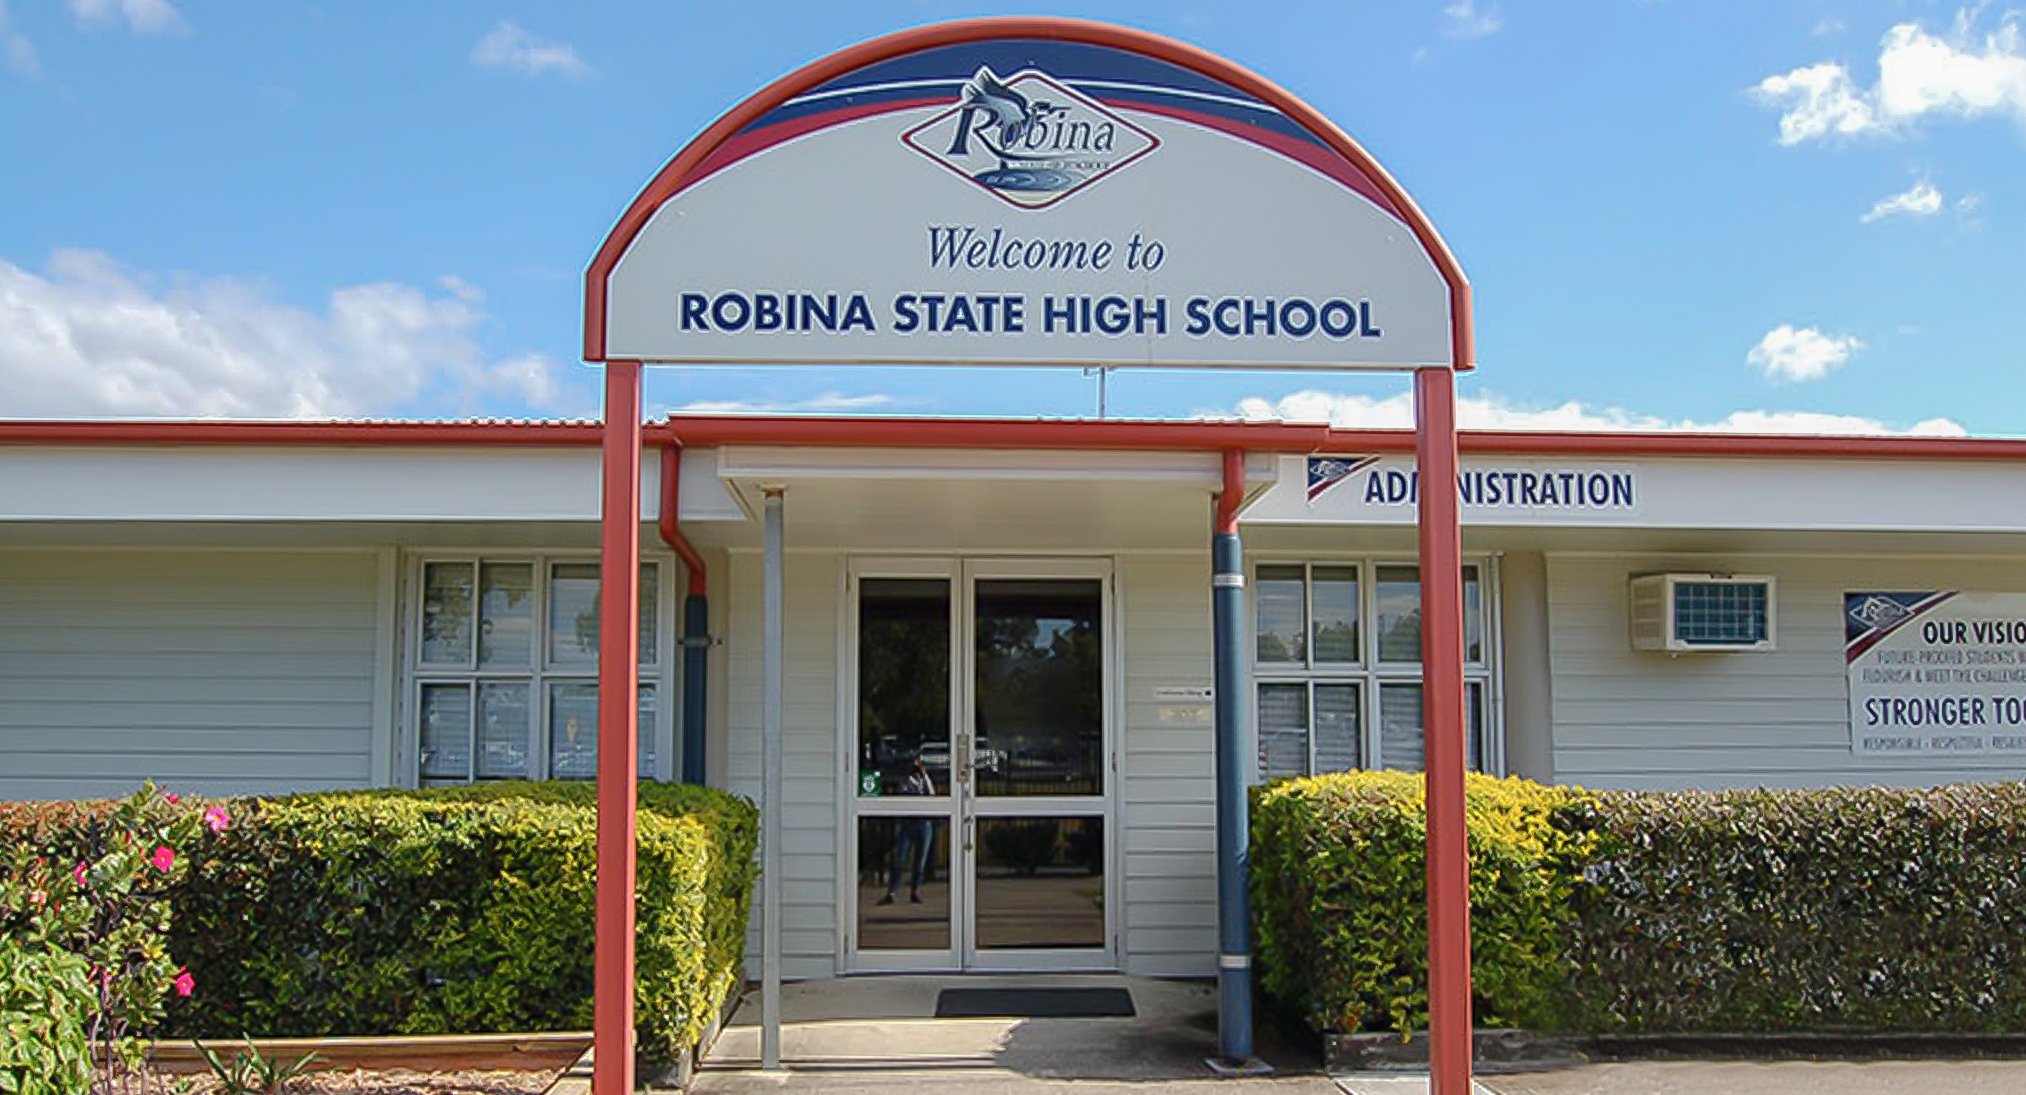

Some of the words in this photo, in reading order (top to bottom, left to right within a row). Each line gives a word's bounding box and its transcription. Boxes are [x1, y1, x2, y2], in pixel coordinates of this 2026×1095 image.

[947, 103, 1113, 156] Robina
[928, 227, 1112, 270] Welcome
[1127, 233, 1164, 271] to
[681, 293, 876, 331] ROBINA
[893, 294, 1024, 333] STATE
[1044, 296, 1166, 335] HIGH
[1185, 298, 1381, 338] SCHOOL
[1365, 471, 1632, 506] ADNISTRATION
[1923, 621, 1968, 645] OUR
[1865, 697, 1986, 726] STRONGER
[1992, 697, 2026, 726] TO
